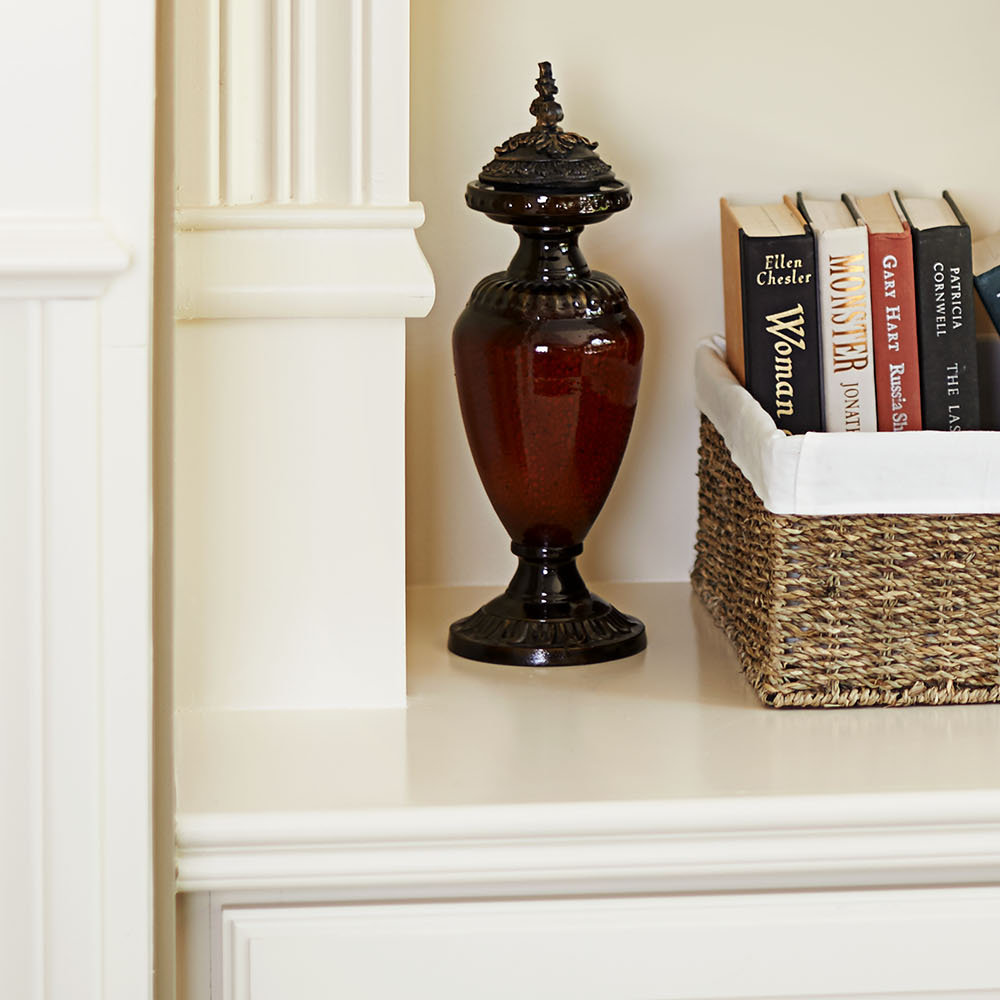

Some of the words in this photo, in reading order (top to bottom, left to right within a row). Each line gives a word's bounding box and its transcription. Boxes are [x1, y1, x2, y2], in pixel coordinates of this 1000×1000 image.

[756, 269, 811, 285] Chesler
[765, 254, 802, 269] Ellen
[882, 255, 897, 298] GARY
[829, 253, 869, 373] MONSTER
[933, 262, 946, 337] CORNWELL
[950, 267, 962, 329] PATRICIA
[885, 305, 901, 351] HART
[765, 303, 806, 418] Woman
[946, 363, 959, 396] THE
[889, 363, 907, 411] Russia
